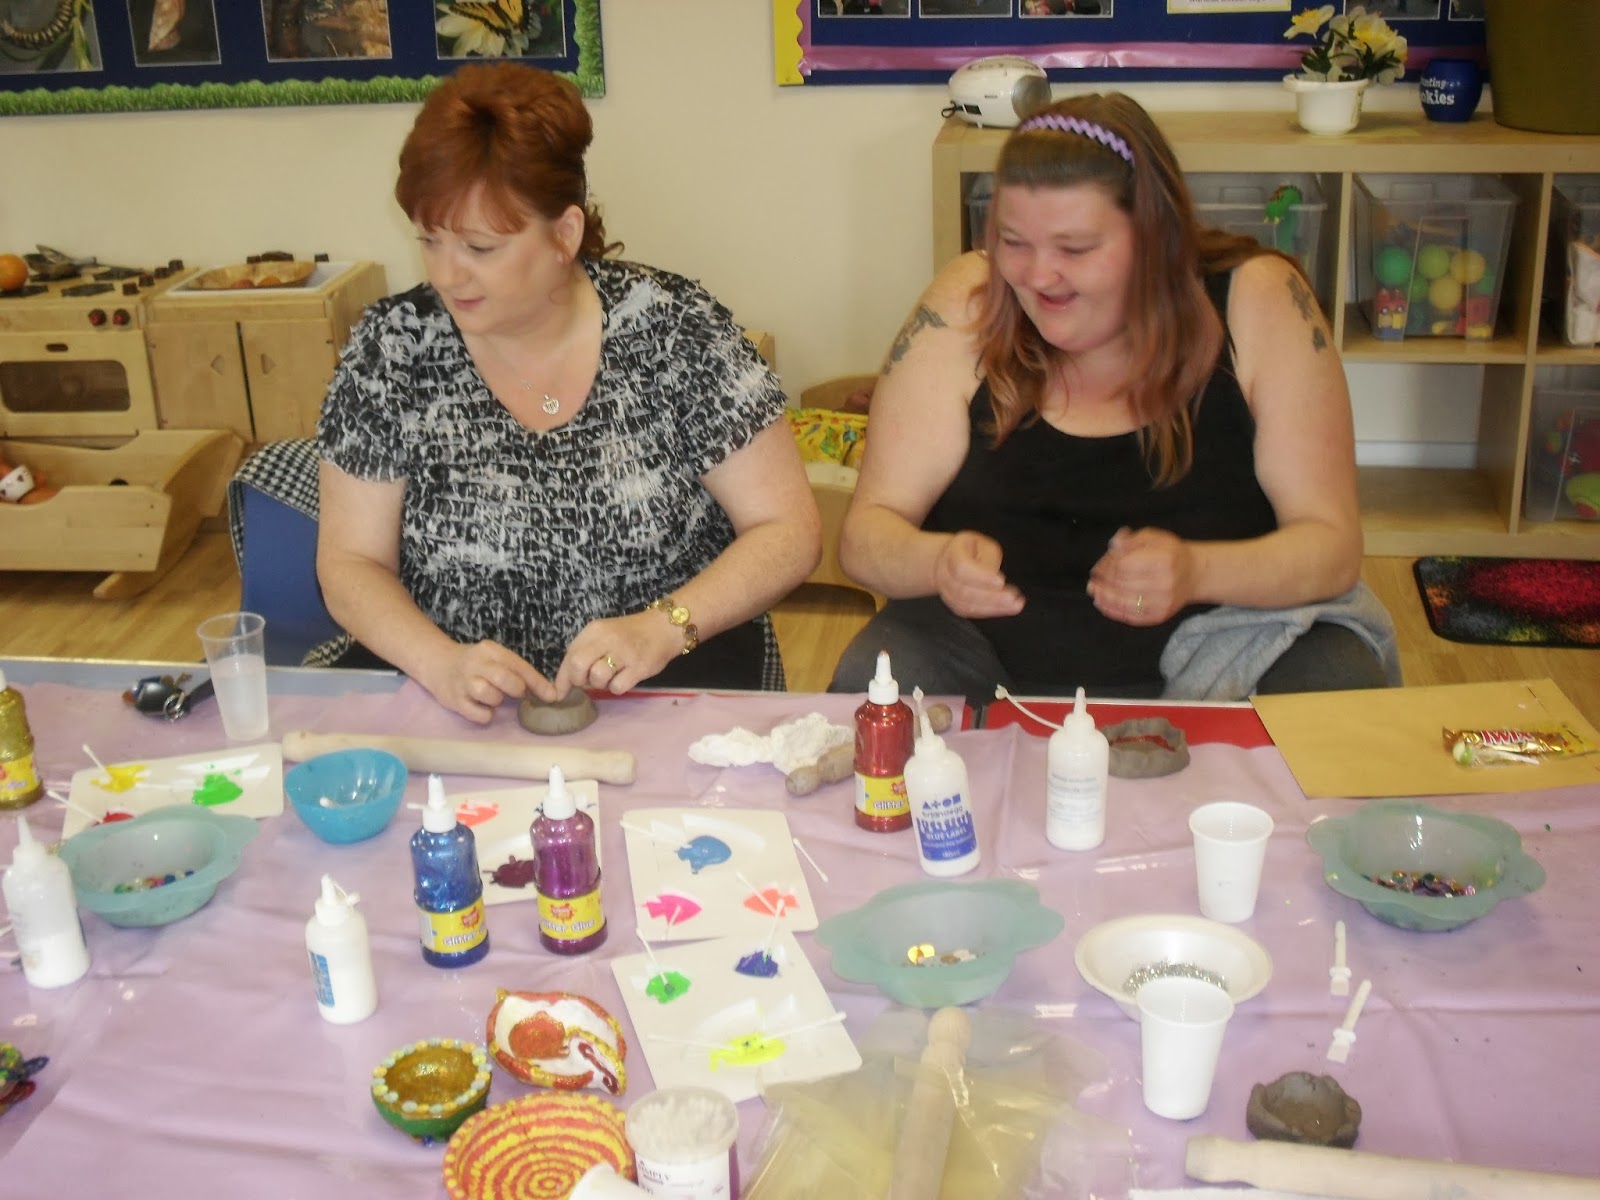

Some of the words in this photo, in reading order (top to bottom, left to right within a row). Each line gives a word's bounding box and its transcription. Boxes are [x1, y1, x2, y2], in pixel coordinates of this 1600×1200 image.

[1481, 730, 1535, 746] TWIX
[925, 832, 945, 841] BLUE
[946, 827, 967, 840] LABEL
